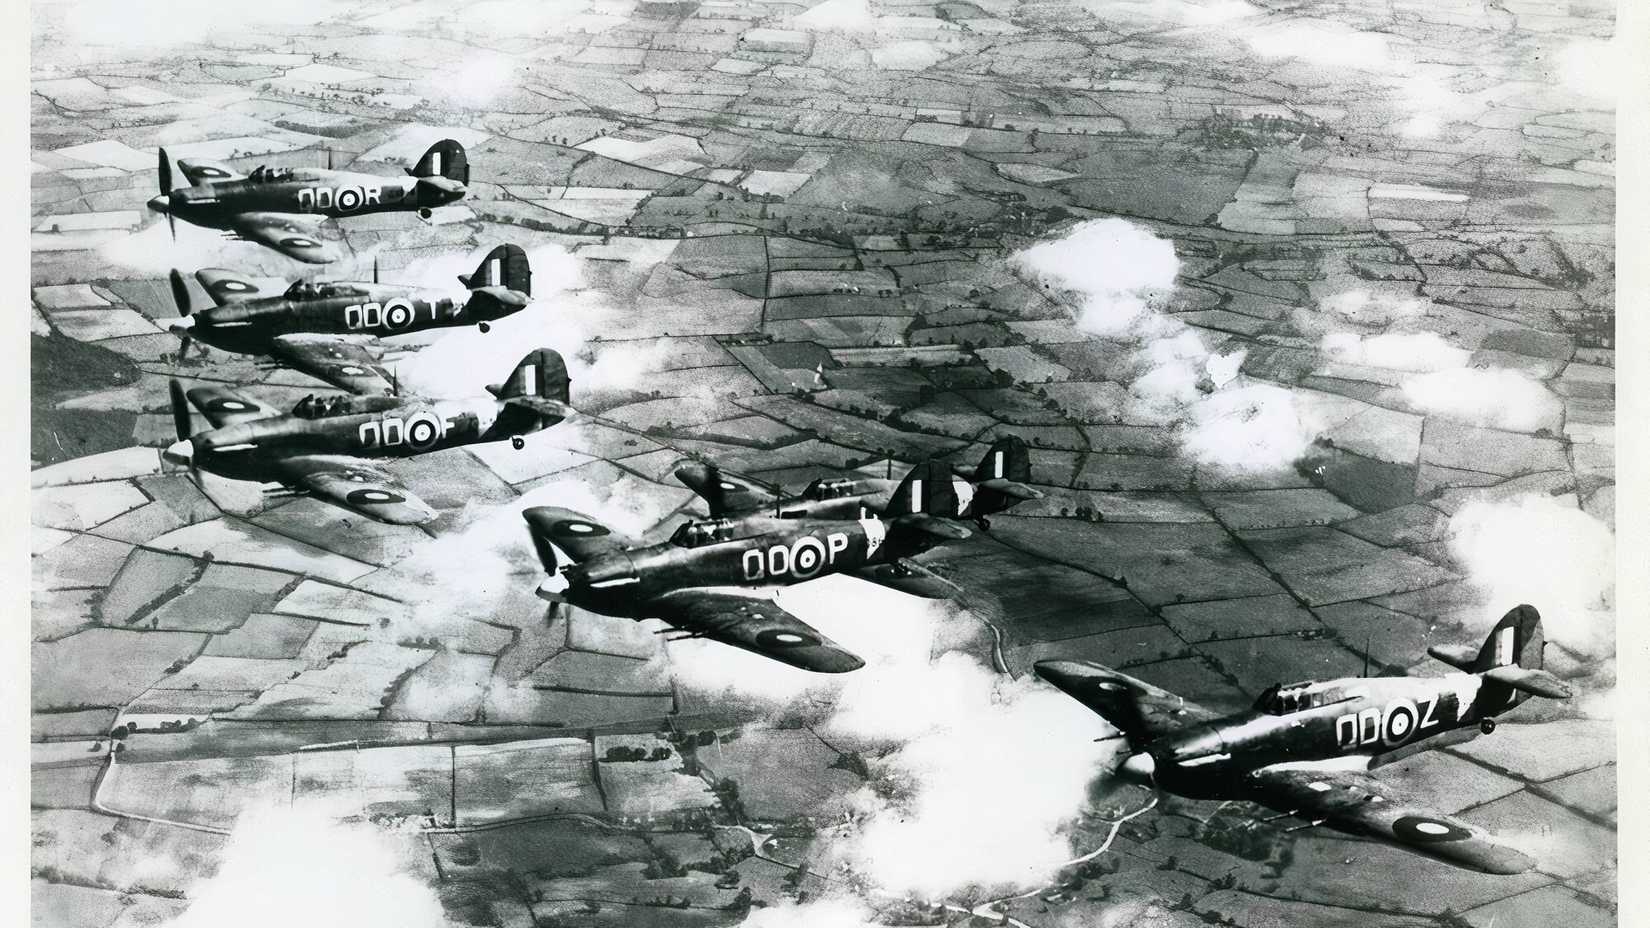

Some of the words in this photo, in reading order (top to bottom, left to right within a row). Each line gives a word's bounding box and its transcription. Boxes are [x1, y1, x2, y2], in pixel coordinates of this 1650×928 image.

[363, 184, 382, 206] R
[421, 300, 441, 320] T
[439, 415, 456, 439] F
[827, 532, 849, 565] P
[1417, 691, 1440, 729] Z
